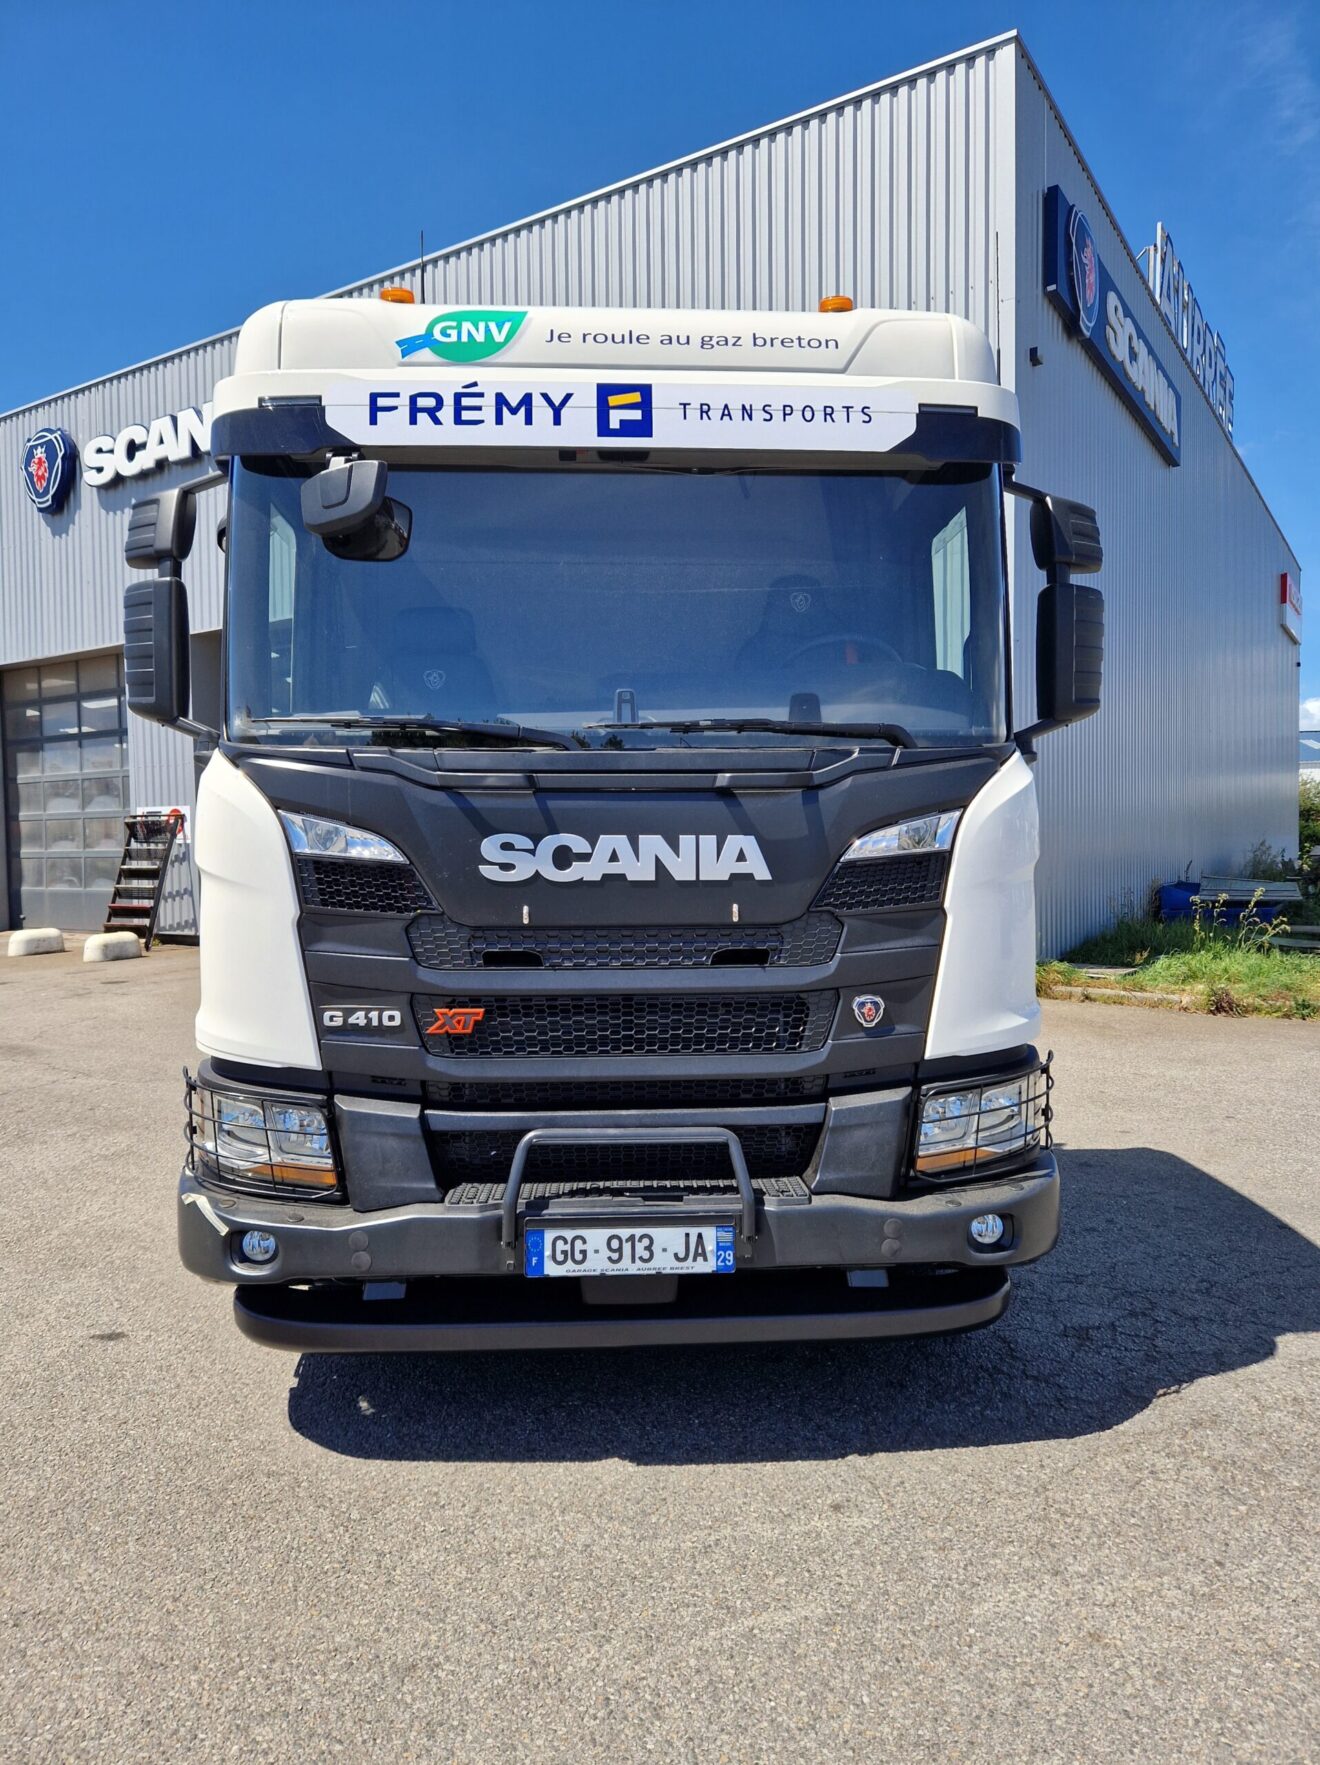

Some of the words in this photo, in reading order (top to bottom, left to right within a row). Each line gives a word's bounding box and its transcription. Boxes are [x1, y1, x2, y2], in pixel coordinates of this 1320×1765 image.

[432, 319, 513, 344] GNV
[545, 328, 572, 344] Je
[582, 329, 651, 346] roule
[660, 333, 690, 347] au
[700, 334, 743, 351] gaz
[752, 333, 840, 351] breton
[1105, 290, 1179, 448] SCANIA
[368, 380, 575, 427] FRÉMY
[678, 402, 874, 424] TRANSPORTS
[478, 833, 772, 881] SCANIA
[323, 1011, 344, 1027] G
[348, 1010, 402, 1027] 410
[425, 1008, 486, 1035] XT
[532, 1256, 538, 1267] F
[717, 1251, 734, 1265] 29
